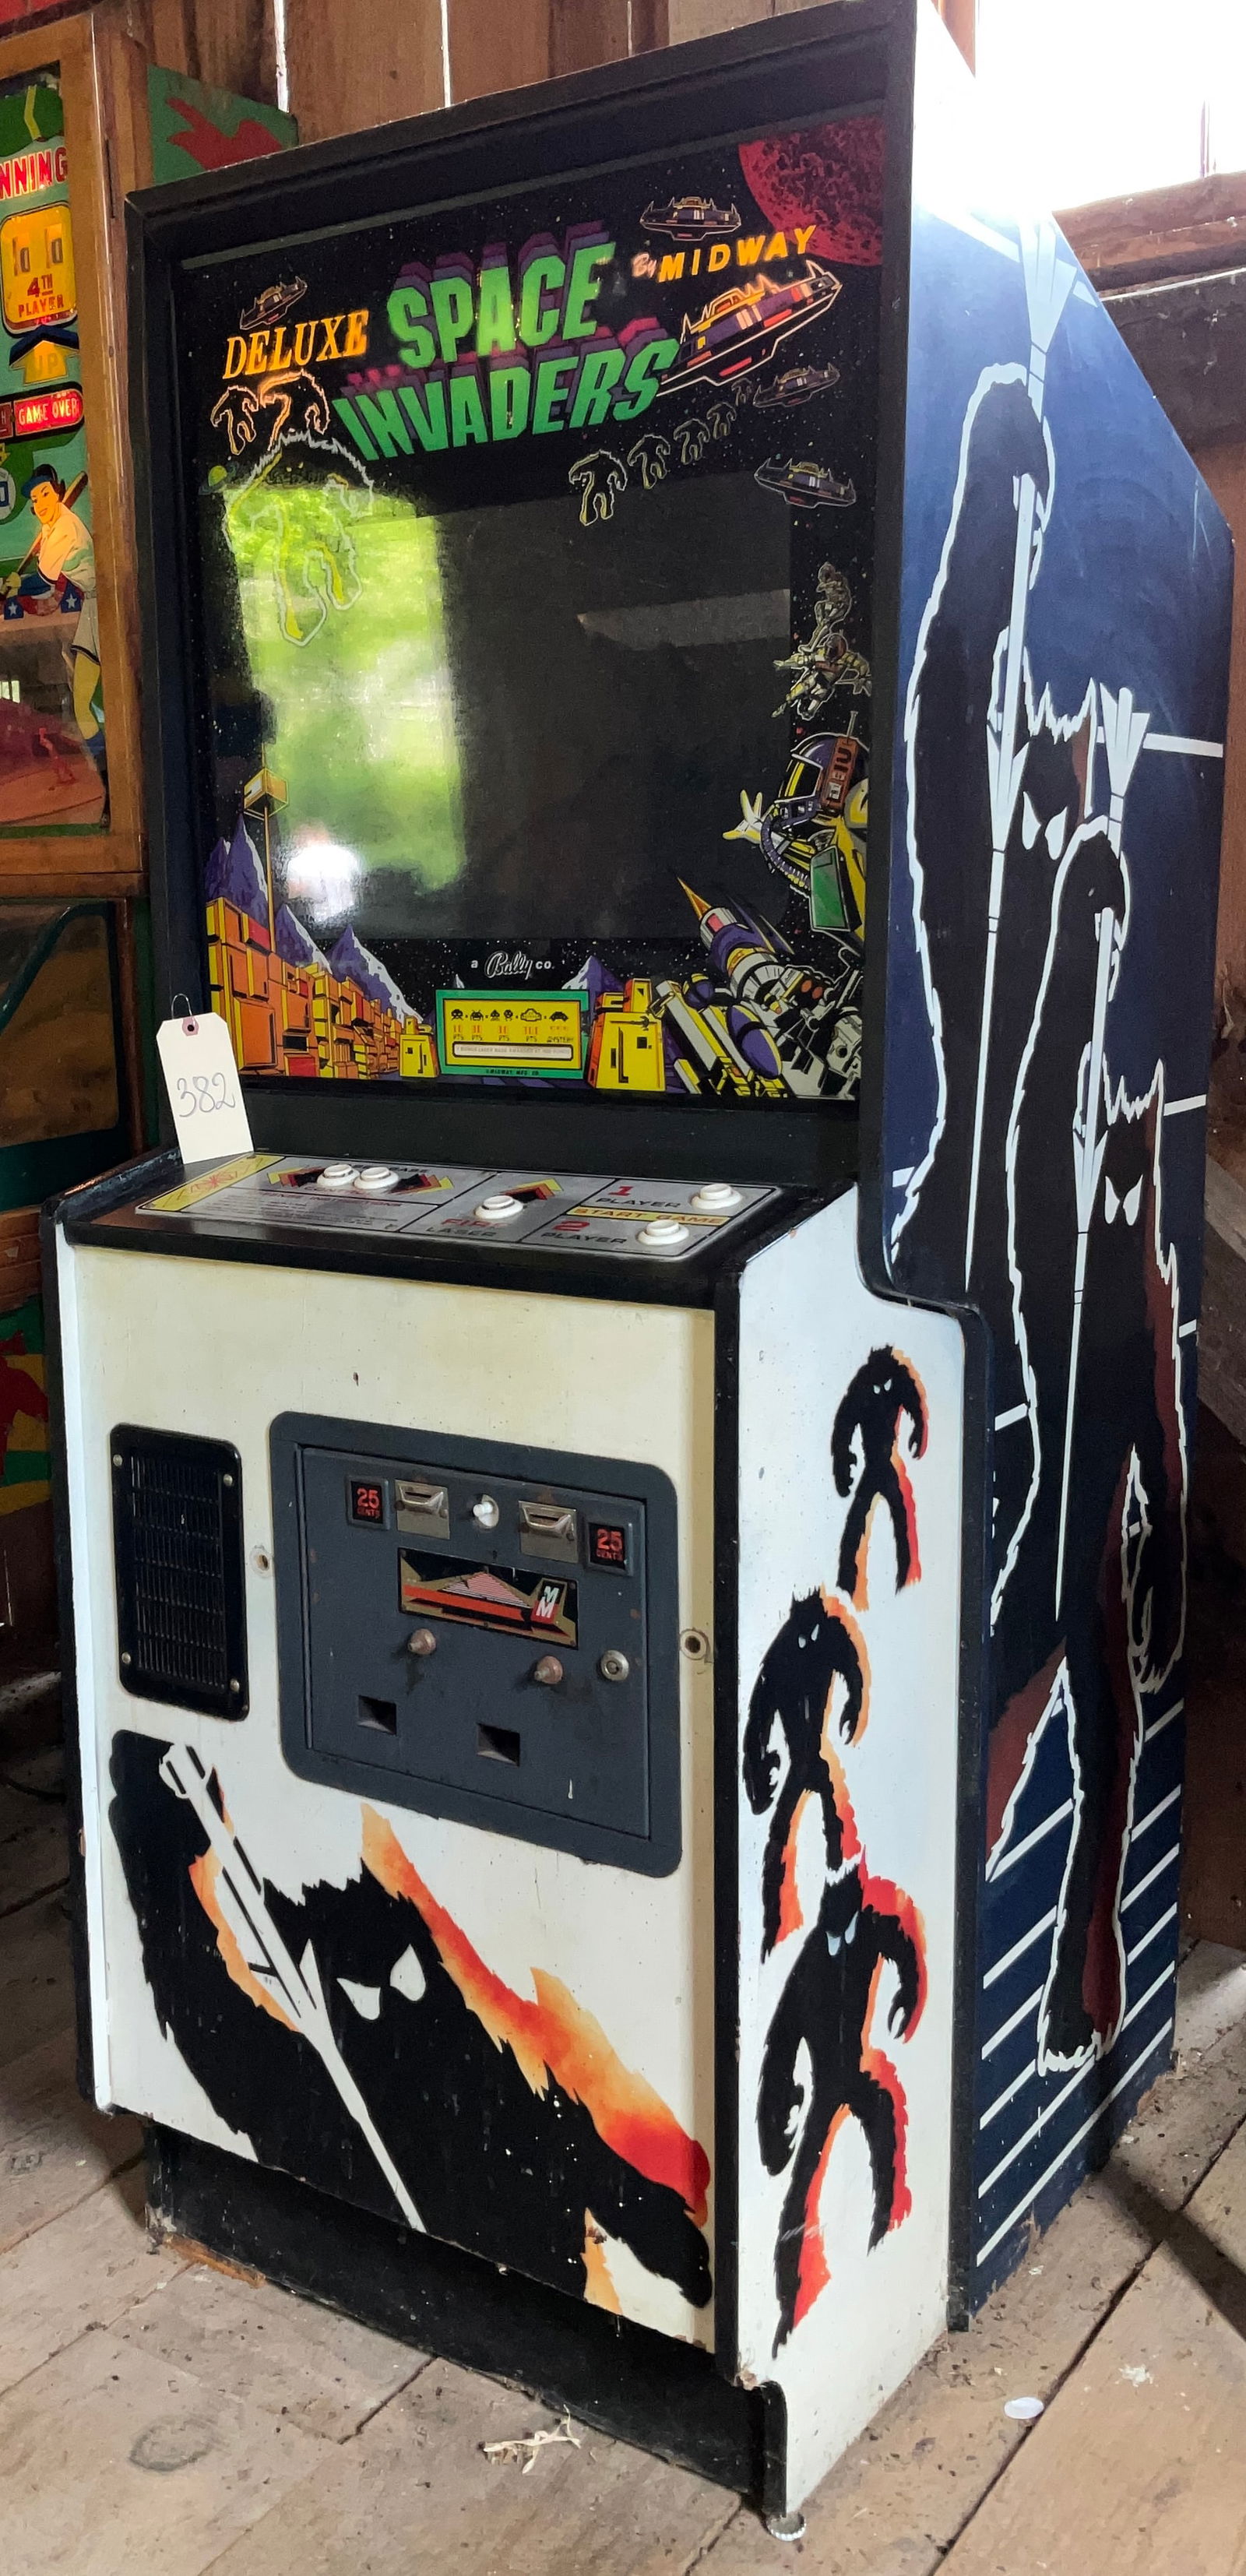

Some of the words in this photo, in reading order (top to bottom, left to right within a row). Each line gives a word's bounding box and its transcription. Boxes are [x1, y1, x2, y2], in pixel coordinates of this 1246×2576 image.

[659, 224, 816, 283] MIDWAY
[18, 294, 64, 318] PLAYER
[387, 241, 616, 368] SPACE
[222, 308, 370, 379] DELUXE
[333, 336, 681, 461] INVADERS
[19, 403, 48, 426] GAME
[52, 397, 78, 418] OVER
[470, 959, 478, 969] a
[484, 950, 533, 980] Bally
[176, 1072, 236, 1118] 382
[595, 1197, 681, 1208] PLAYER
[608, 1186, 634, 1197] 1
[551, 1220, 591, 1232] 2
[573, 1208, 645, 1219] START
[656, 1213, 727, 1225] GAME
[426, 1226, 498, 1237] LASER
[540, 1232, 628, 1244] PLAYER
[357, 1488, 380, 1509] 25
[597, 1528, 623, 1552] 25
